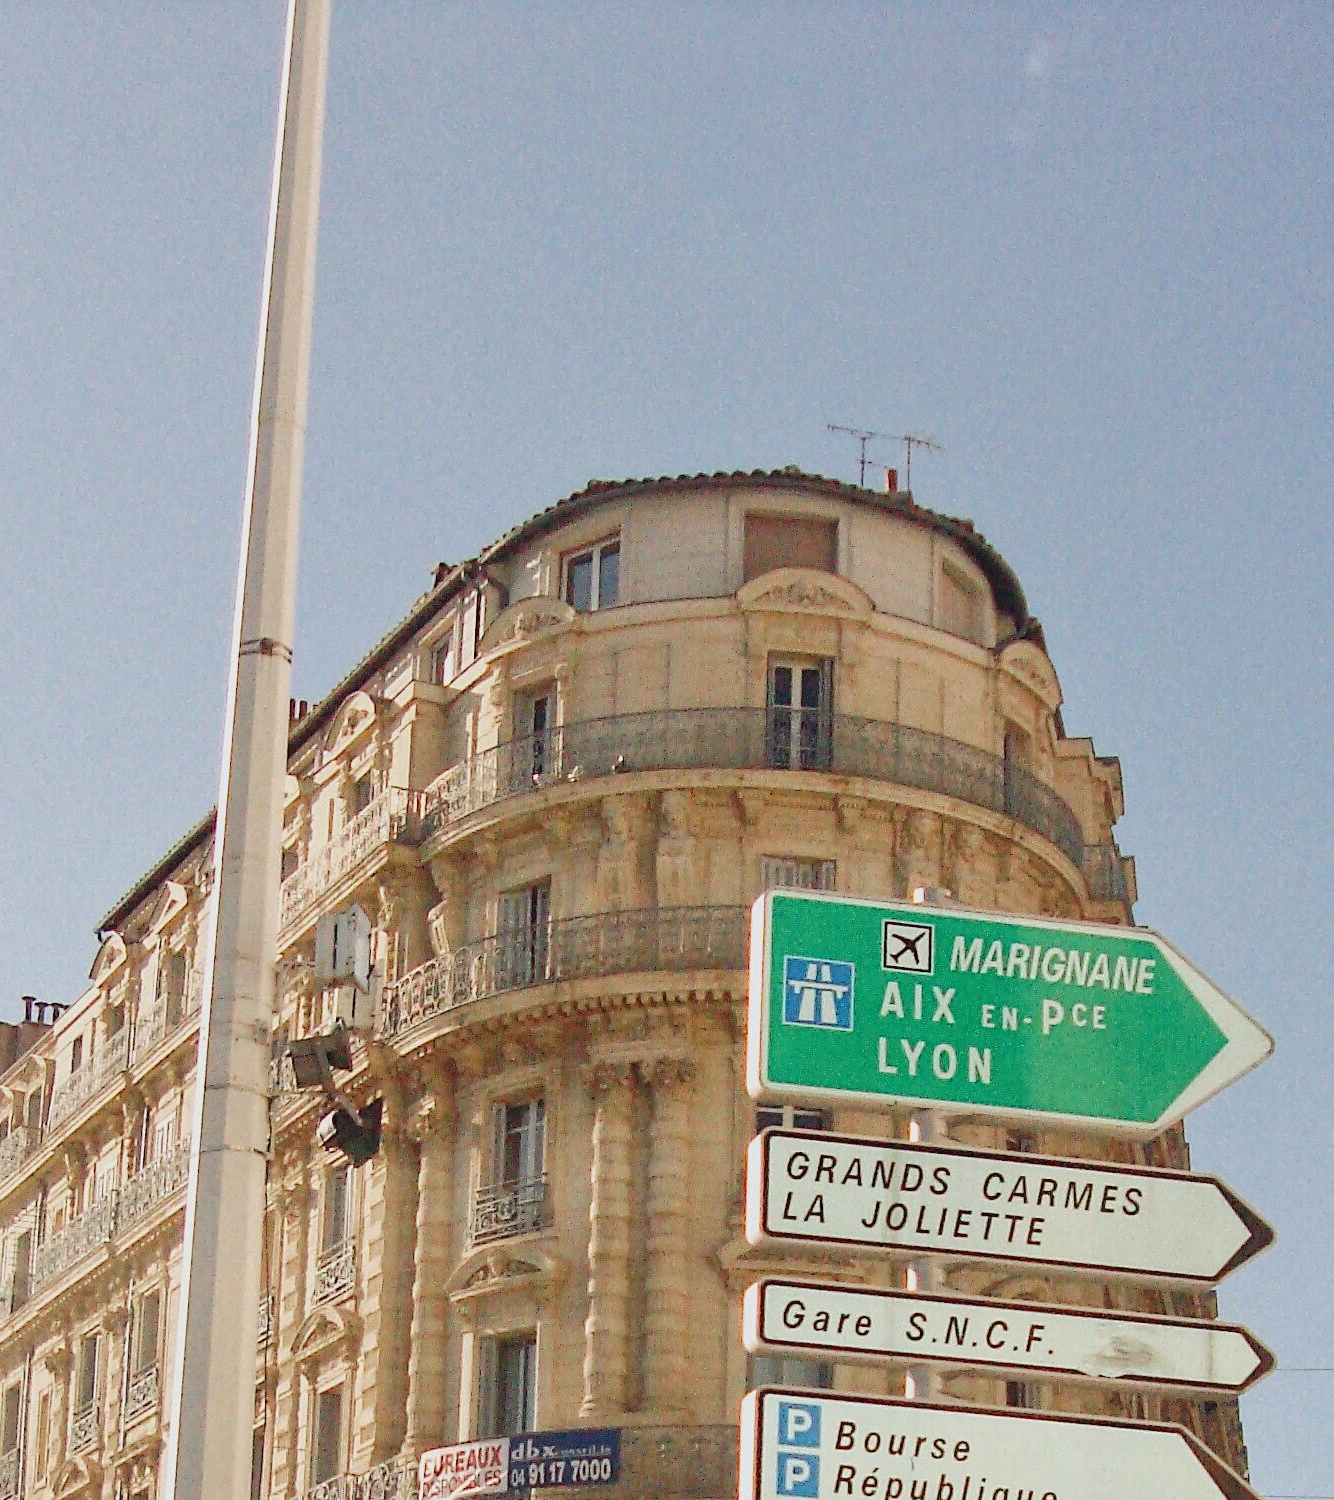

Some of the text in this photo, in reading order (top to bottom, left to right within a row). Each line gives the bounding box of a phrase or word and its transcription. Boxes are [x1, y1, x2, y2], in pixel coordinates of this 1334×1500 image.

[949, 936, 1157, 995] MARIGNANE
[879, 981, 957, 1025] AIX
[877, 1036, 992, 1084] LYON
[786, 1151, 1144, 1218] GRANDS CARMES
[782, 1192, 1045, 1247] LA JOLIETTE
[782, 1300, 1056, 1355] Gare S.N.C.F.
[834, 1421, 971, 1463] Bourse
[528, 1461, 546, 1486] 91
[548, 1460, 566, 1484] 17
[570, 1458, 612, 1483] 7000
